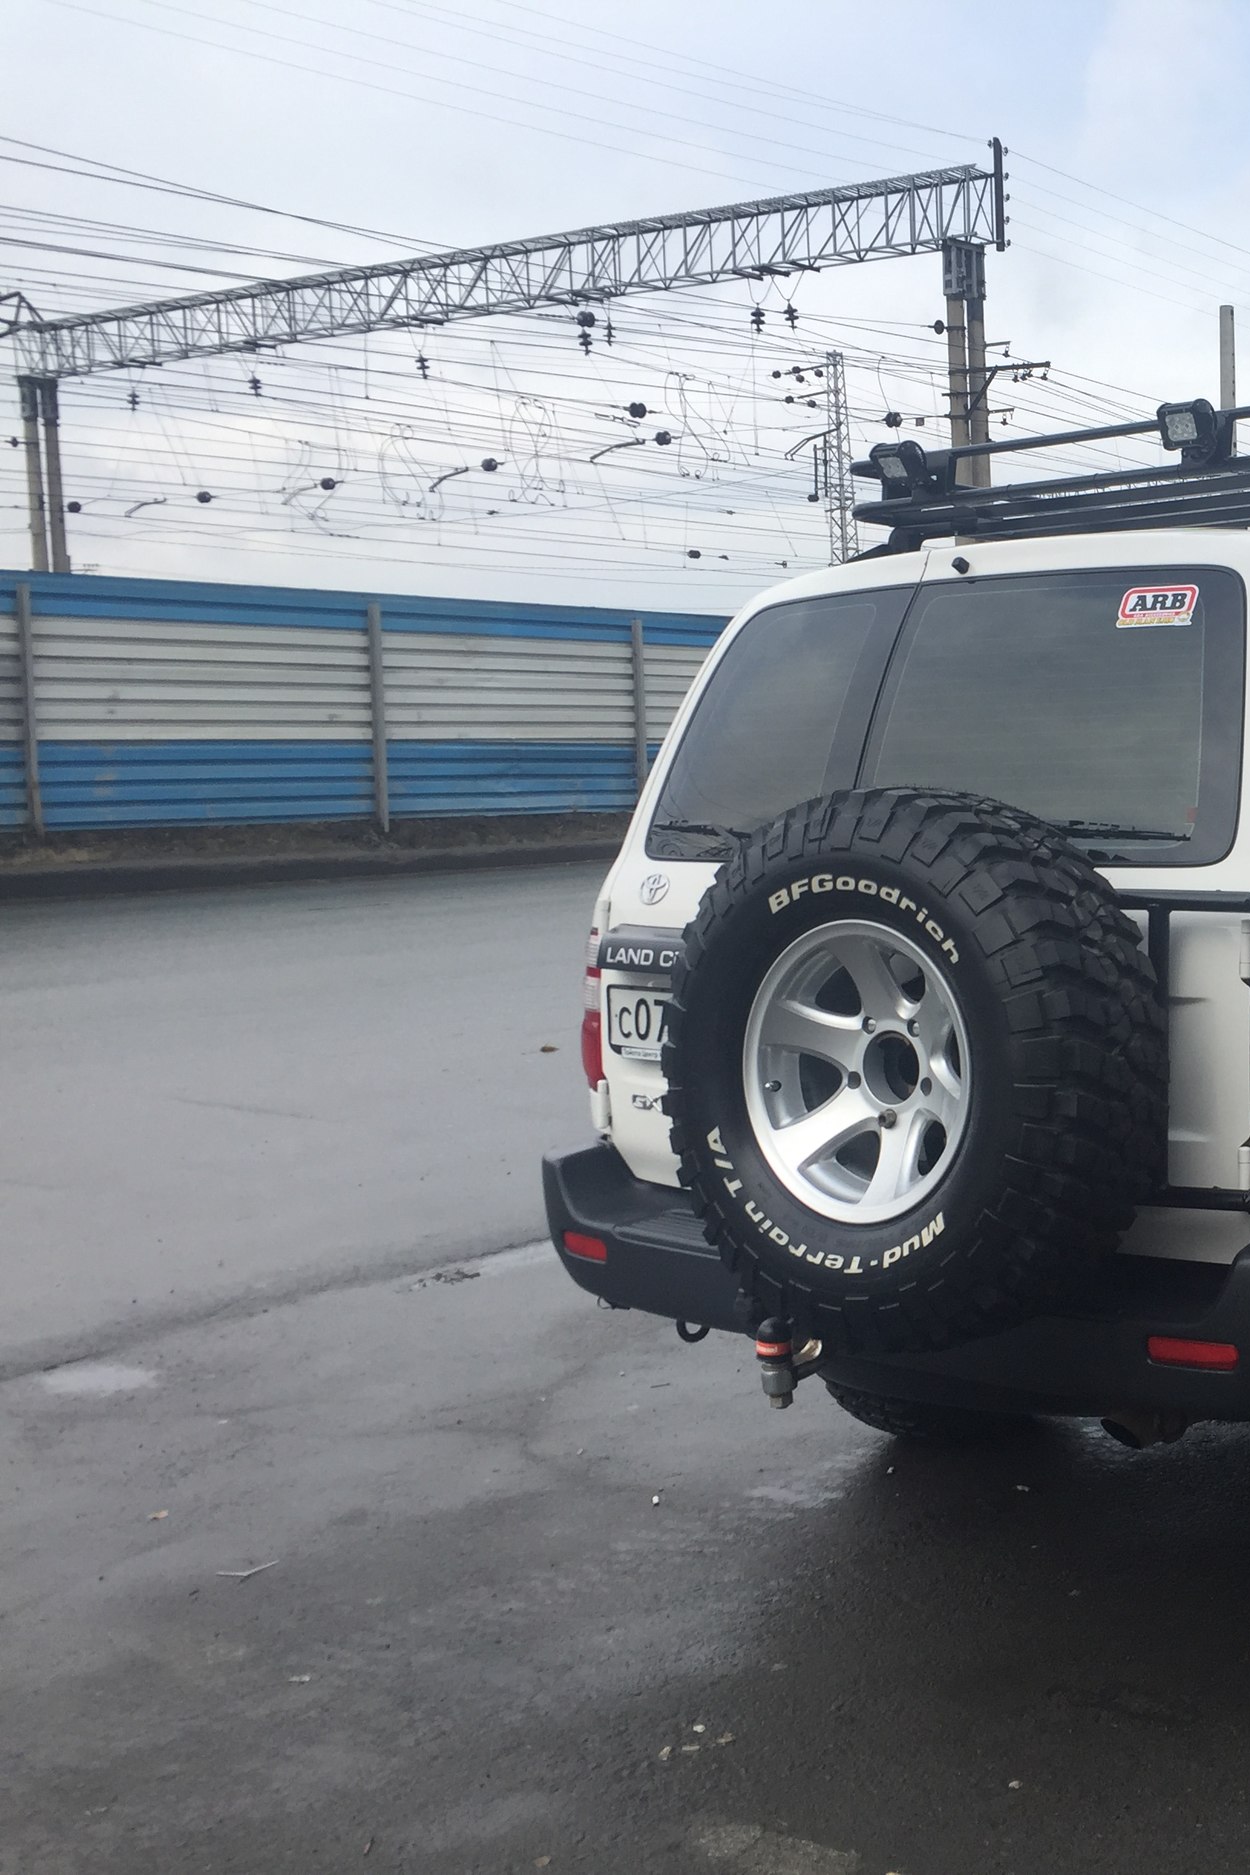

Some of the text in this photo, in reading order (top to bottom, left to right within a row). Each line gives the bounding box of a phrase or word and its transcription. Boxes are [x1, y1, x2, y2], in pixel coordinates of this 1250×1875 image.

[1128, 593, 1188, 612] ARB
[768, 874, 960, 964] BFGoodrich
[606, 947, 654, 966] LAND
[706, 1125, 744, 1199] T/A
